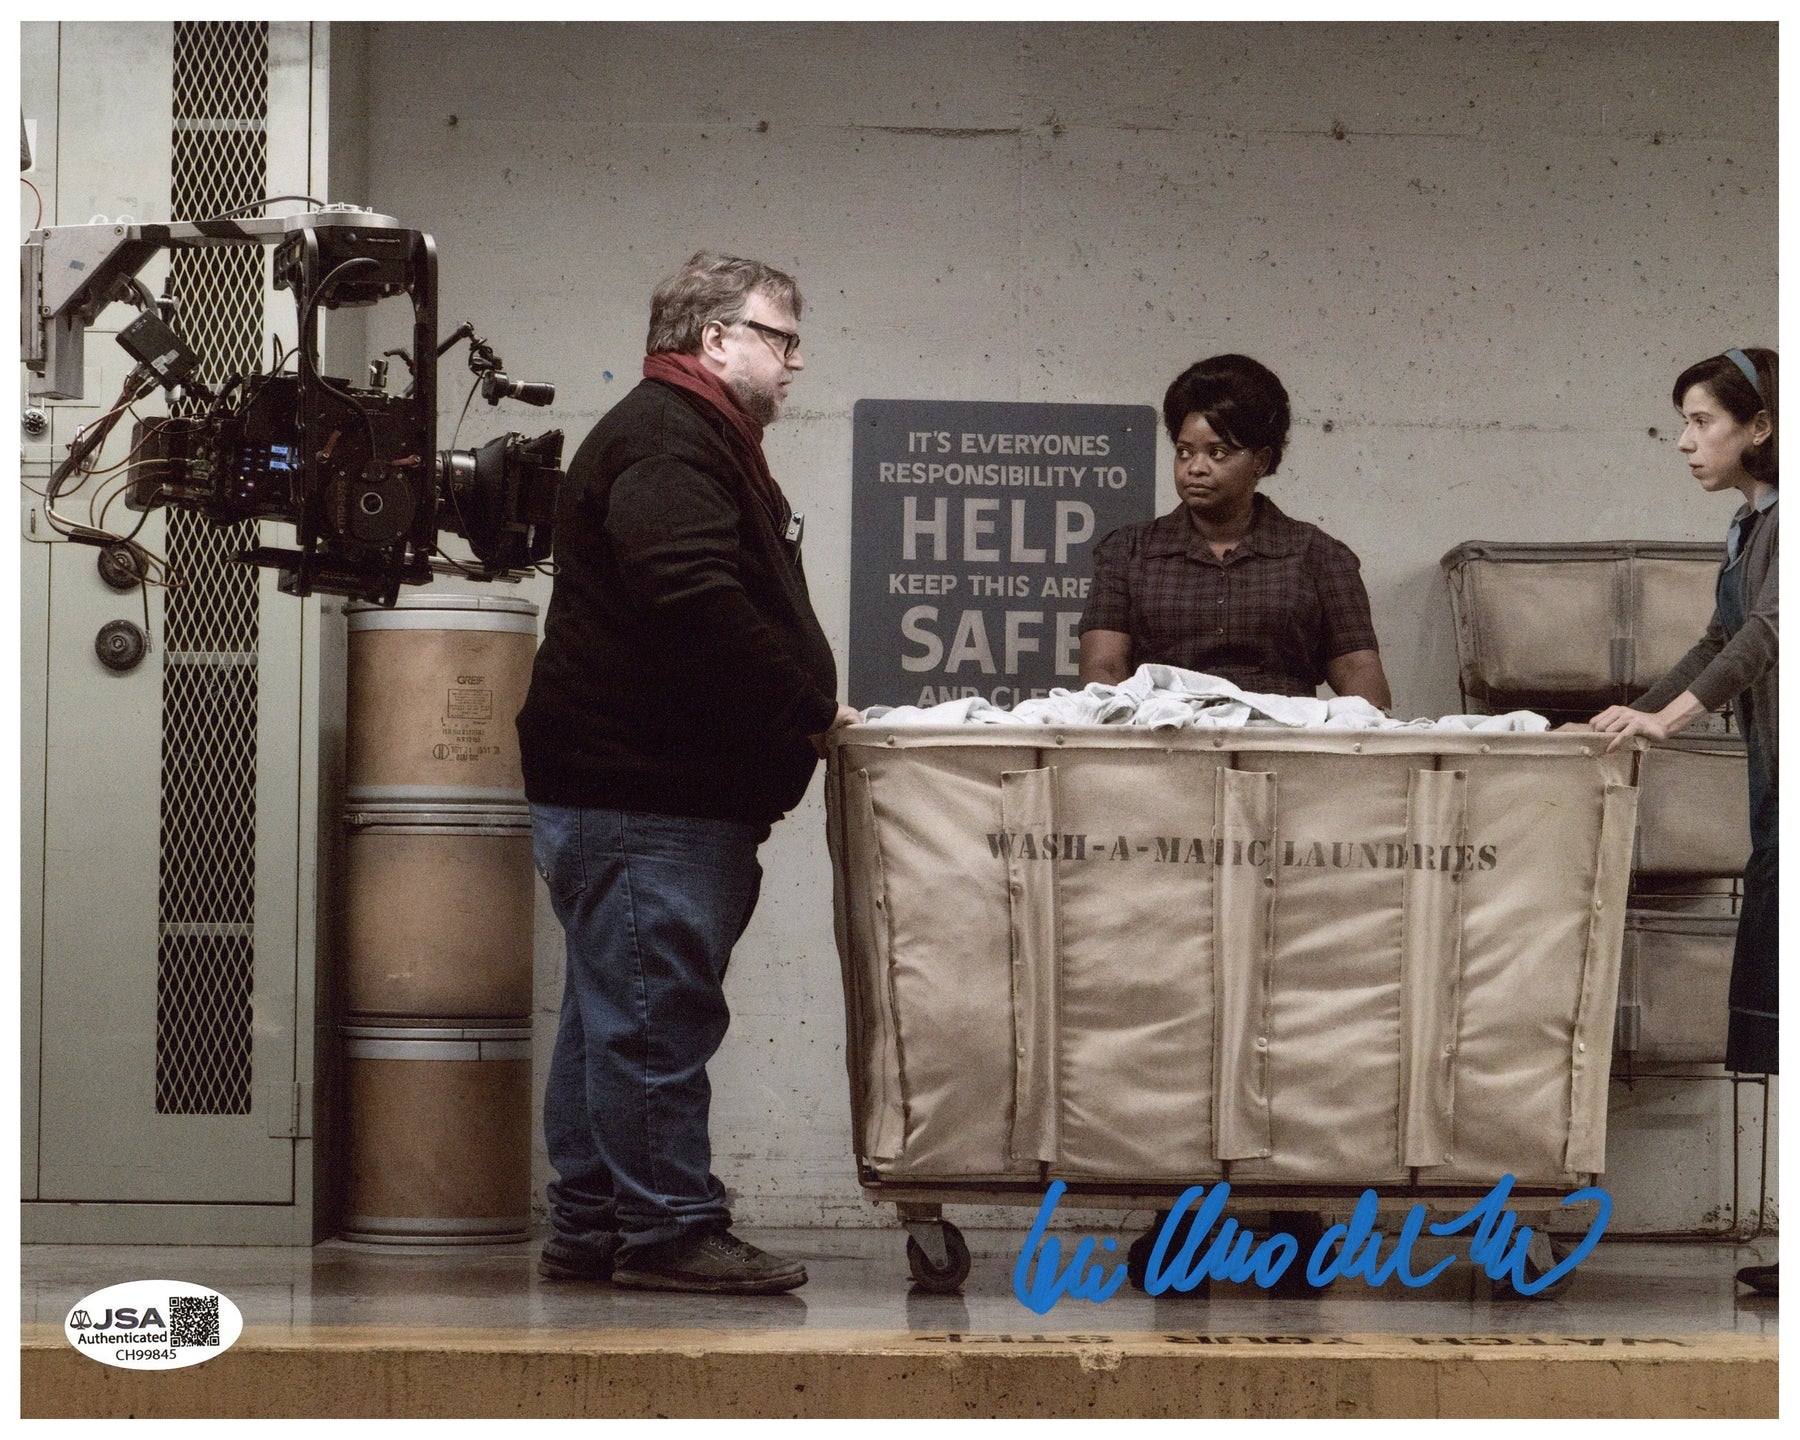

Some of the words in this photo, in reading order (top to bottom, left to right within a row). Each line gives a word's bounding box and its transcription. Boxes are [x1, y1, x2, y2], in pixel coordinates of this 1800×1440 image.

[908, 432, 951, 454] IT'S
[961, 433, 1110, 456] EVERYONES
[879, 462, 1087, 488] RESPONSIBILITY
[1093, 466, 1127, 489] TO
[903, 496, 1096, 564] HELP
[889, 573, 957, 595] KEEP
[968, 575, 1030, 598] THIS
[1040, 577, 1093, 599] ARE
[901, 604, 1084, 676] SAFE
[456, 675, 485, 685] GREIF
[986, 832, 1267, 867] WASH-A-MATIC
[1283, 840, 1497, 872] LAUNDRIES
[914, 1333, 1114, 1344] STEP
[1163, 1334, 1363, 1345] YOUR
[1411, 1336, 1697, 1347] WATCH
